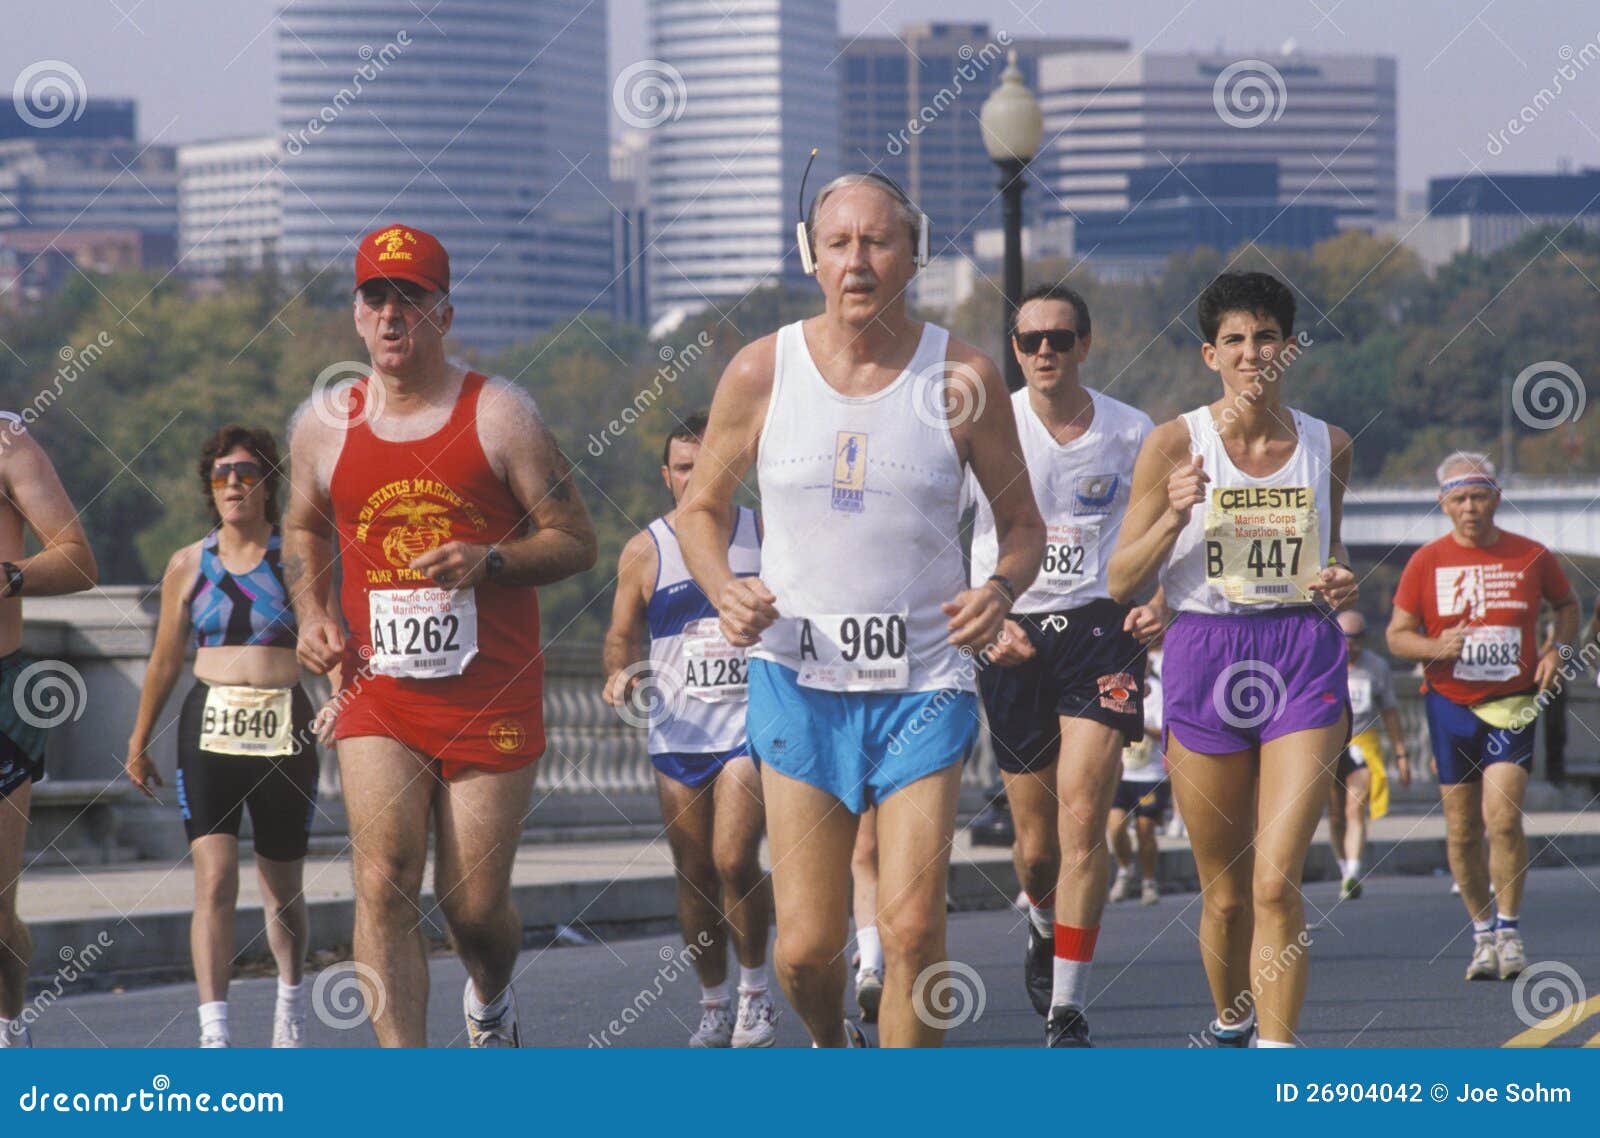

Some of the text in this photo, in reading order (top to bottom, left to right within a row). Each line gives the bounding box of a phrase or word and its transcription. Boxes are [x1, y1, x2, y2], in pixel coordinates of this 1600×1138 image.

[368, 480, 410, 509] STATES
[414, 479, 461, 507] MARINE
[1220, 488, 1307, 510] CELESTE
[1235, 513, 1296, 526] Marine Corps
[1235, 527, 1279, 538] Marathon
[1206, 537, 1303, 578] B 447
[366, 568, 428, 583] CAMP PEN
[391, 590, 452, 603] Marine Corps
[392, 604, 434, 615] Marathon
[374, 615, 460, 655] A1262
[800, 614, 907, 662] A 960
[1459, 642, 1520, 667] 10883
[203, 706, 277, 738] B1640
